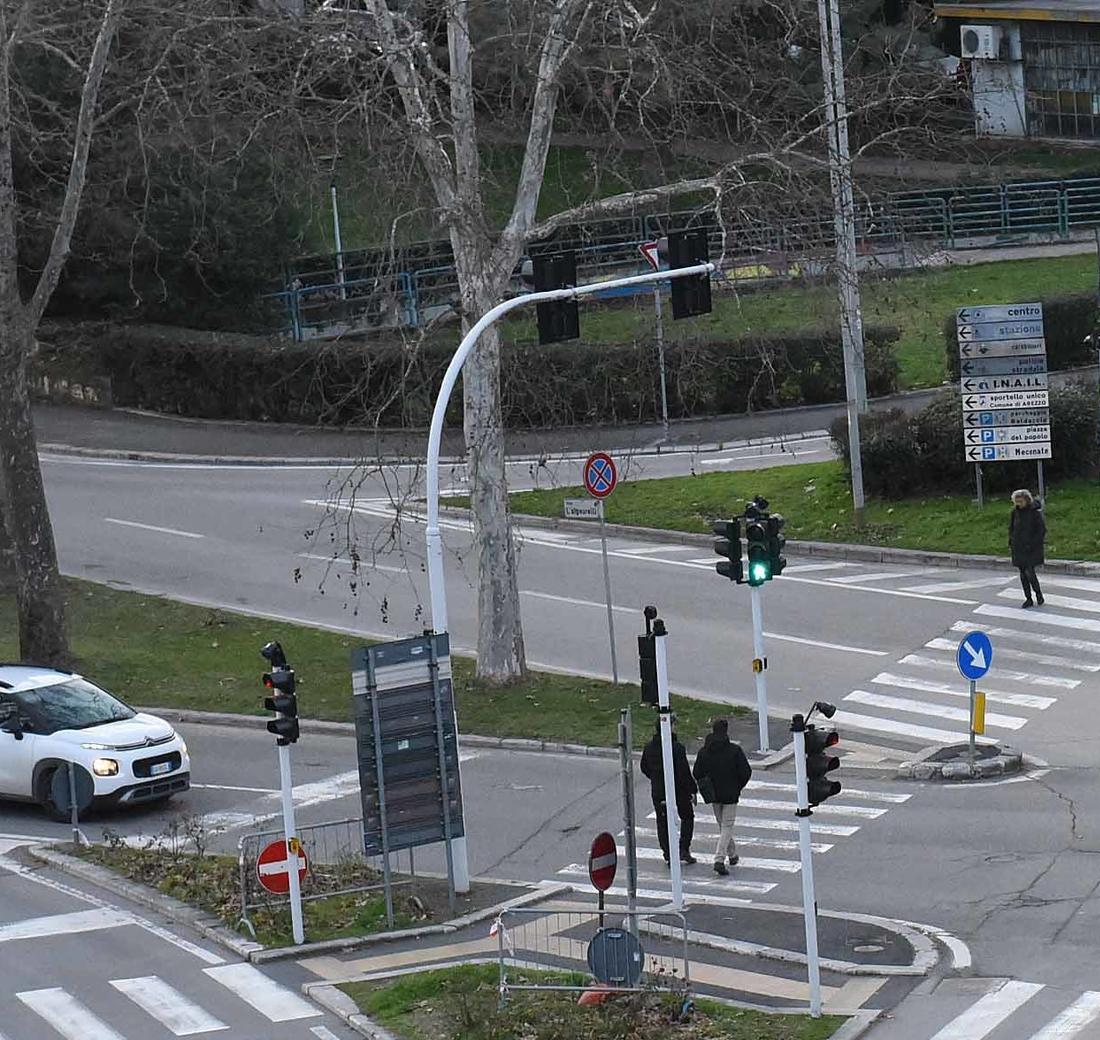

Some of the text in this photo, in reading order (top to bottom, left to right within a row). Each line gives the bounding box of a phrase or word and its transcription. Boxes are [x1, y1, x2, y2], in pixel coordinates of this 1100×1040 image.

[1008, 306, 1040, 316] centro
[1000, 326, 1041, 335] stazione
[993, 378, 1045, 388] I.N.A.I.L.
[990, 393, 1023, 401] sportello
[1024, 433, 1048, 441] popolo
[1015, 447, 1049, 456] Mecenate
